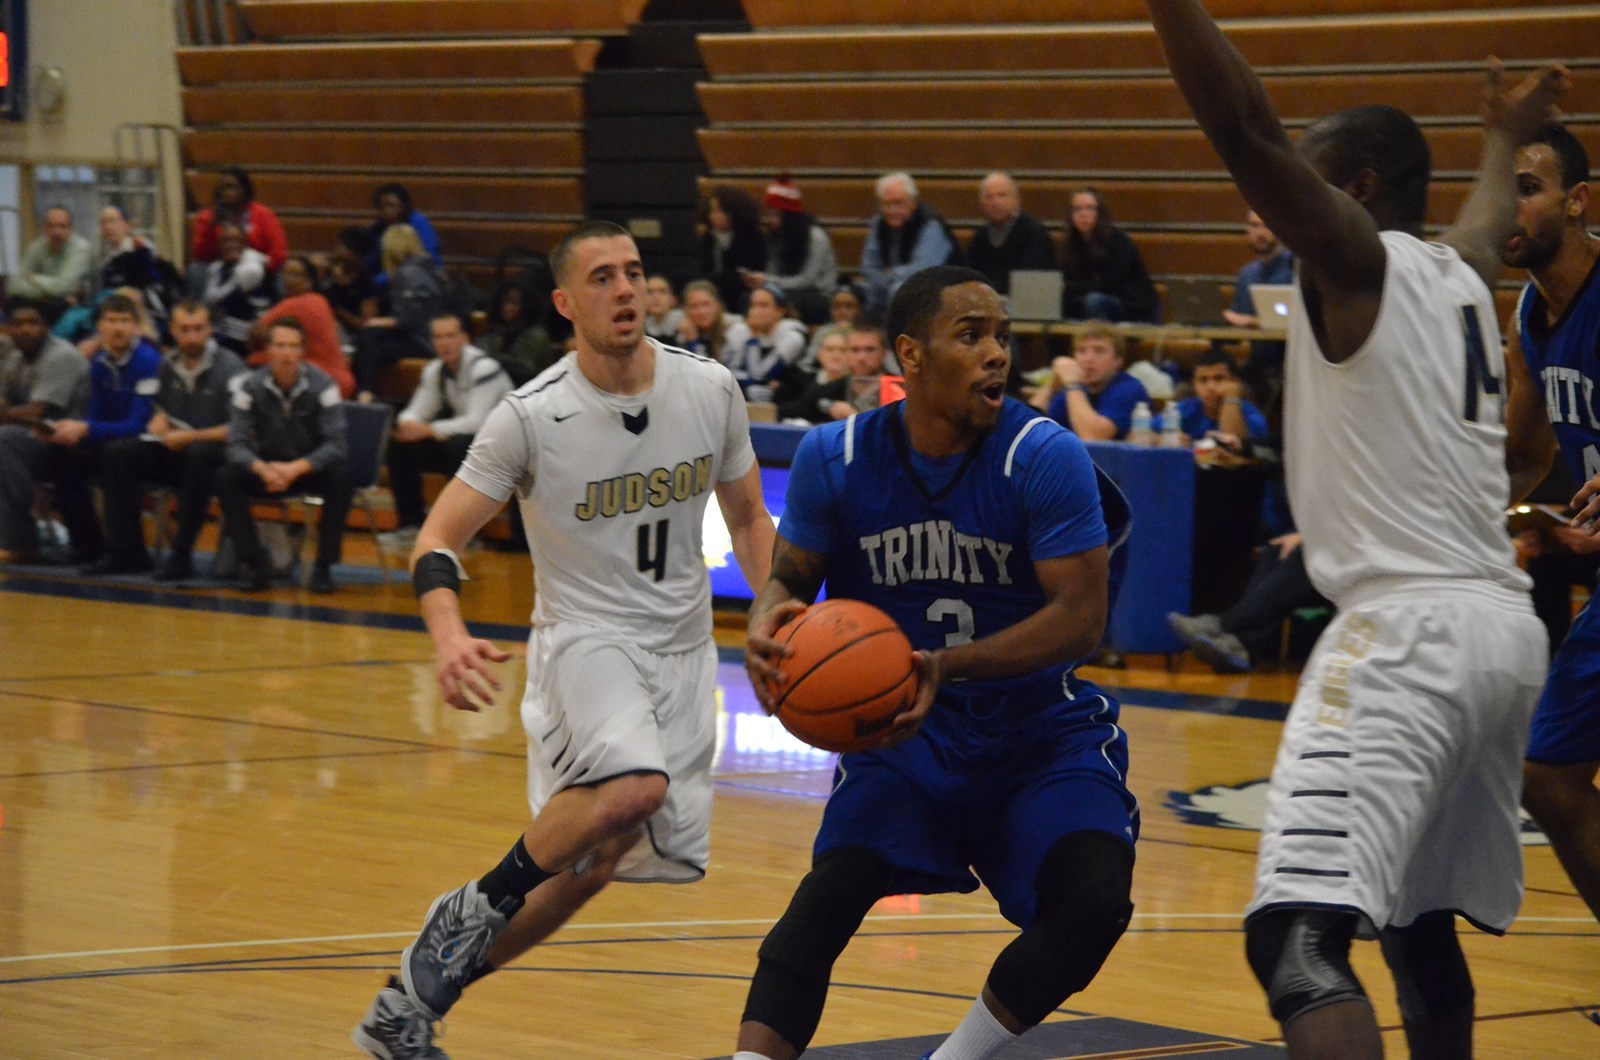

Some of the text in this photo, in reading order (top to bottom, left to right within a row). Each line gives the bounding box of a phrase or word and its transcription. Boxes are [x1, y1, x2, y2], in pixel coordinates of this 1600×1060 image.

[574, 453, 713, 521] JUDSON
[637, 518, 669, 582] 4
[859, 519, 1012, 586] TRINITY
[926, 598, 975, 649] 3
